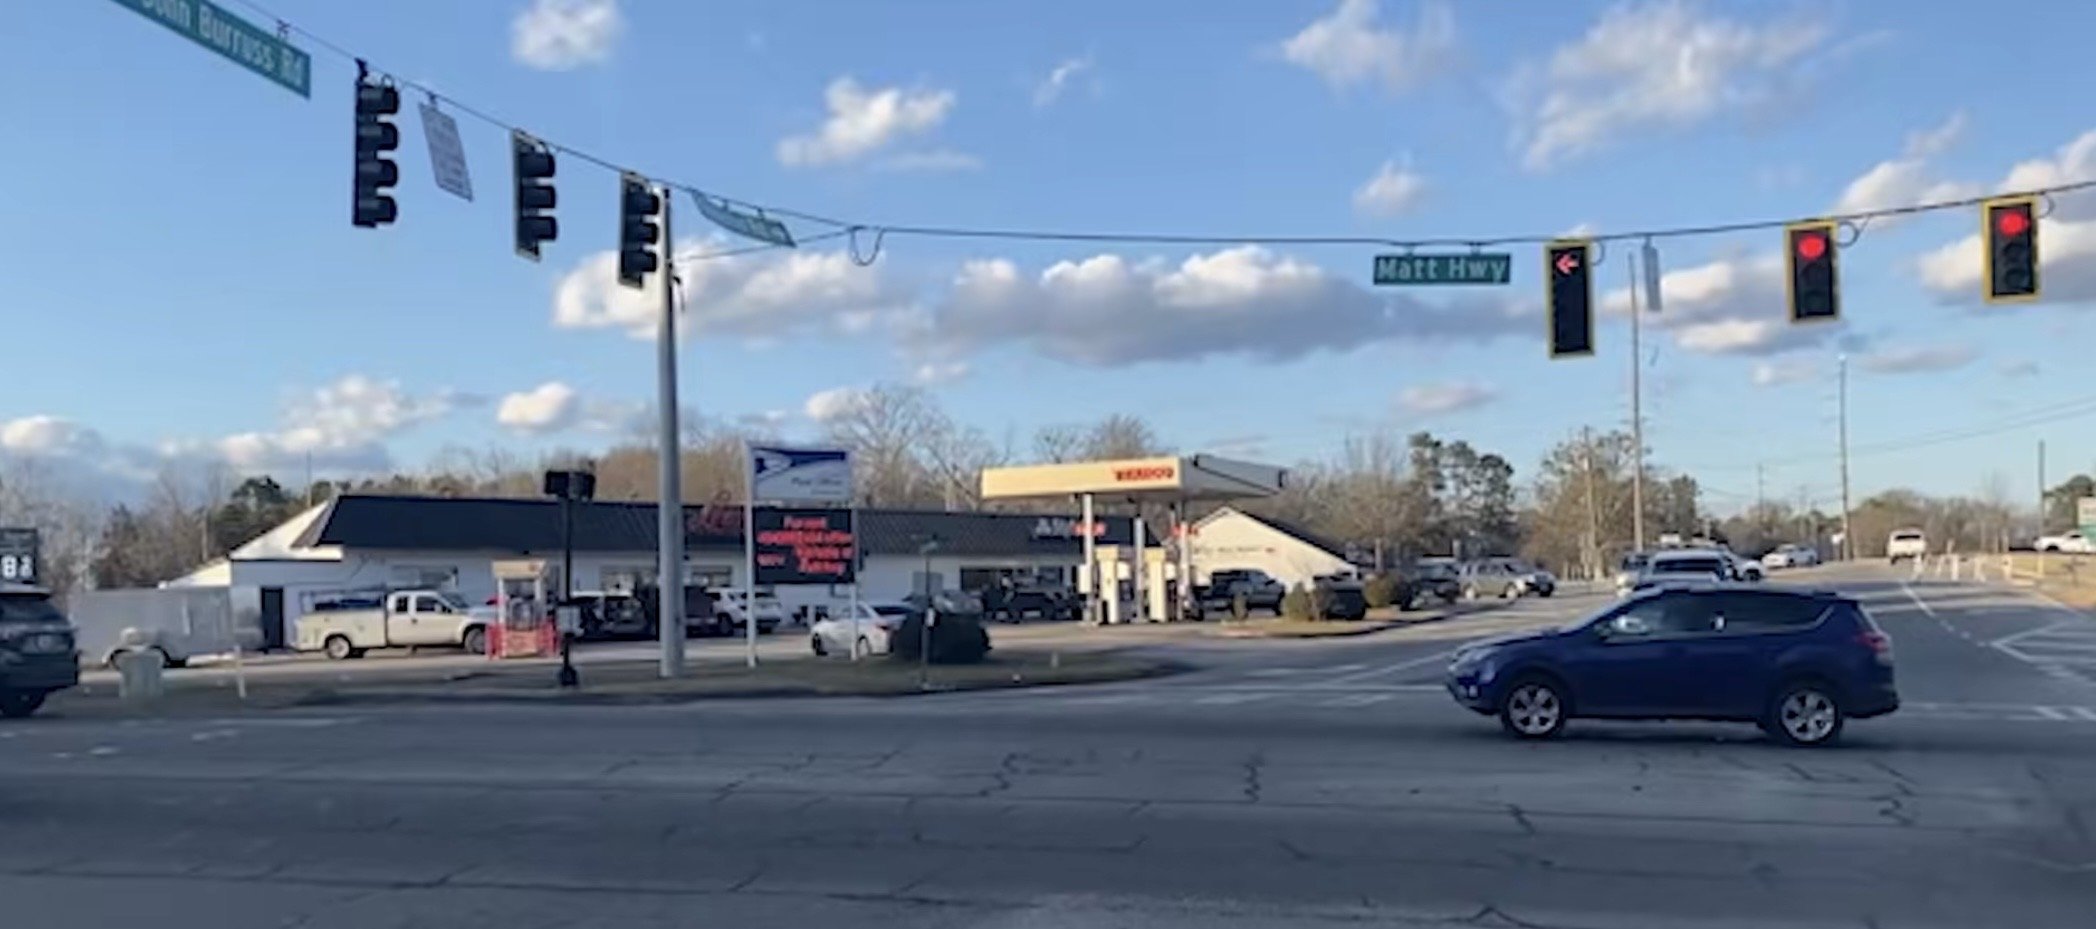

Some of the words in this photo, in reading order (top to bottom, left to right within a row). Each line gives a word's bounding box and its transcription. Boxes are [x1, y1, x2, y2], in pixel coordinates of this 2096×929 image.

[140, 0, 191, 28] ohn
[200, 3, 275, 72] Burruss
[280, 46, 303, 88] Rd
[1379, 257, 1437, 280] Matt
[1446, 257, 1506, 284] Hwy
